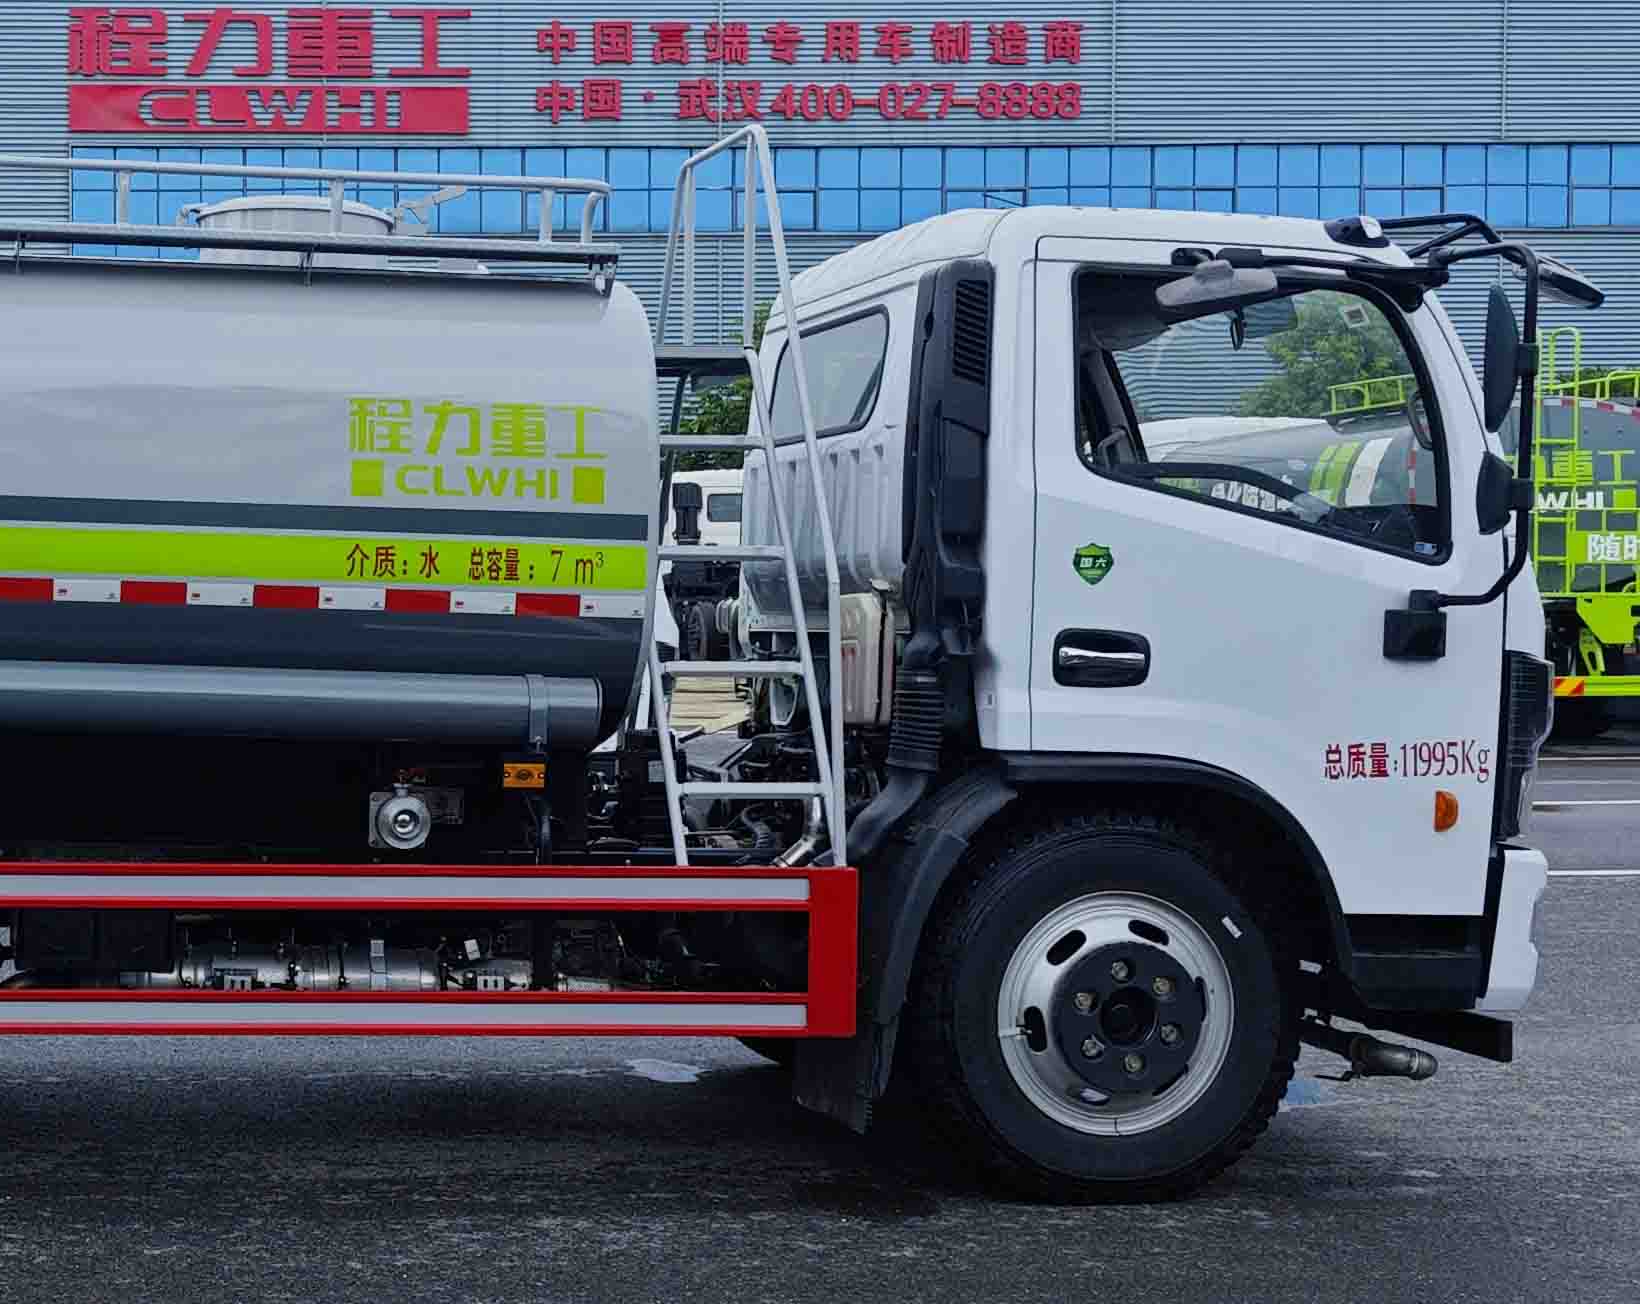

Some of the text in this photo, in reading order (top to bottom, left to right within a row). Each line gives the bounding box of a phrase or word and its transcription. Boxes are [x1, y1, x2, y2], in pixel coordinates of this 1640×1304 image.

[68, 8, 472, 78] 程力重工
[536, 20, 1083, 64] 中国高端专用车制造商
[138, 88, 403, 129] CLWHI
[348, 397, 609, 459] 程力重工
[394, 464, 559, 500] CLWHI
